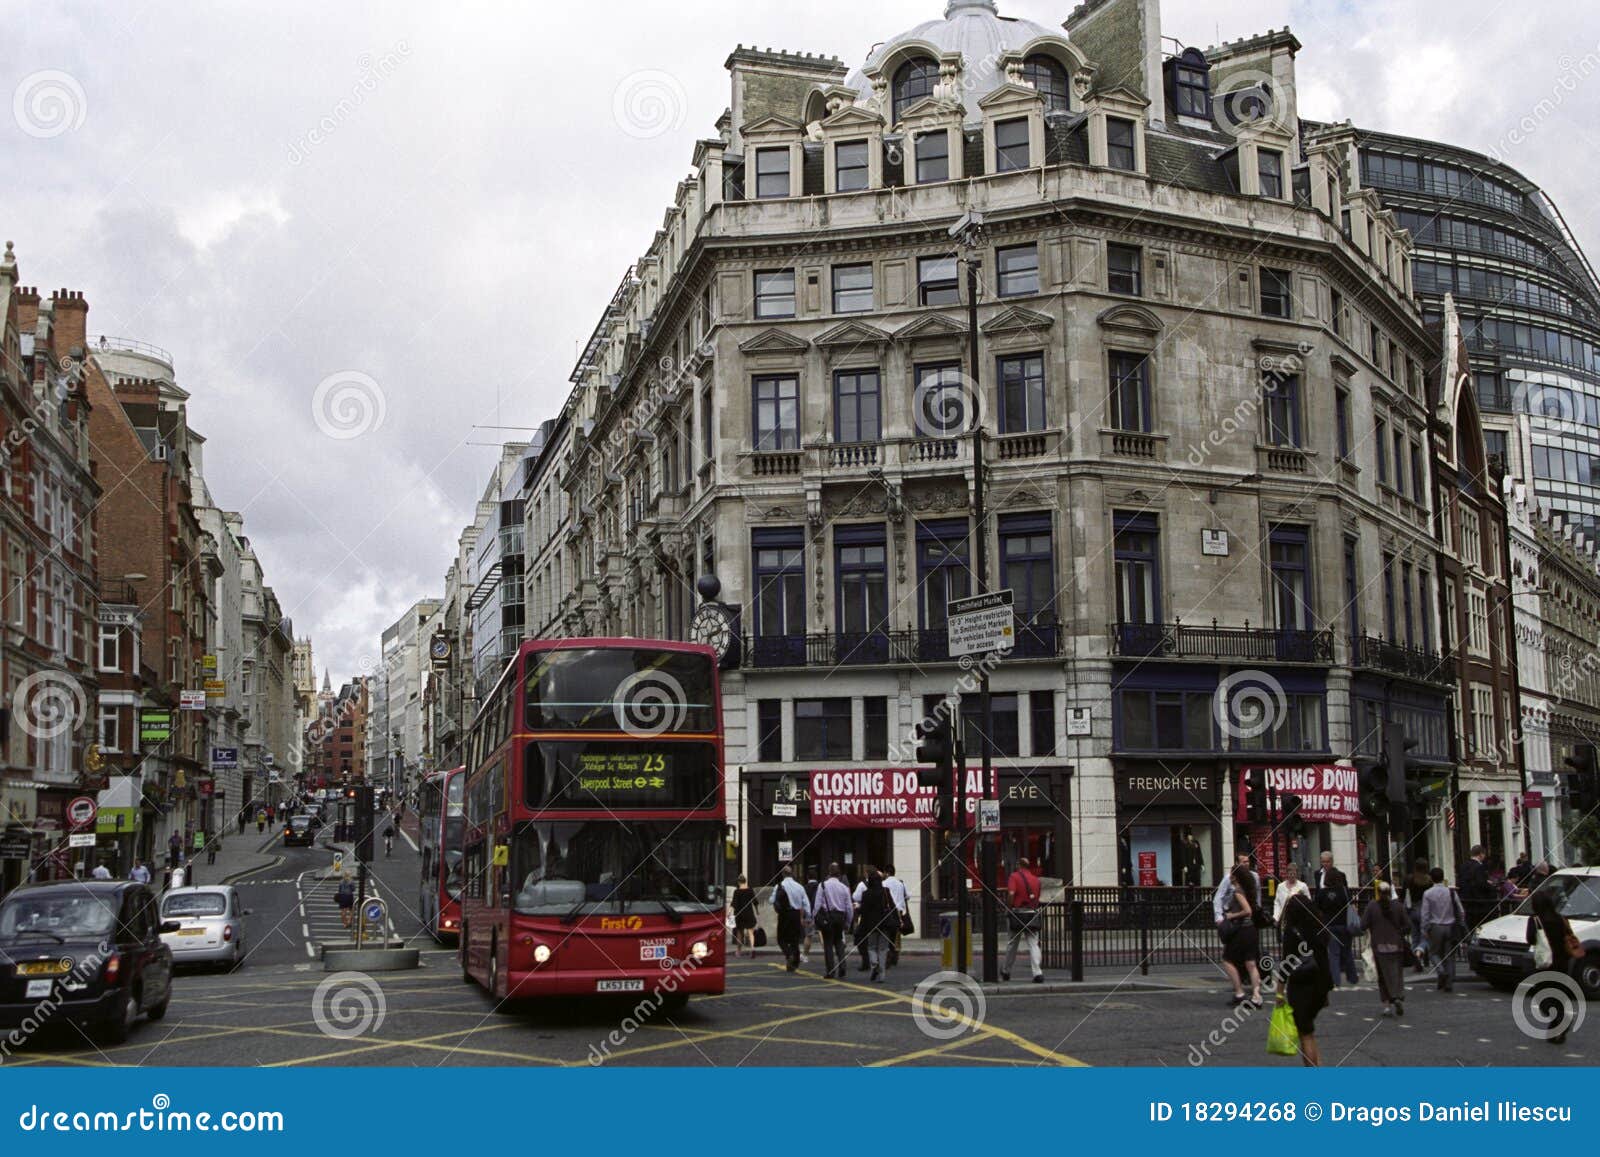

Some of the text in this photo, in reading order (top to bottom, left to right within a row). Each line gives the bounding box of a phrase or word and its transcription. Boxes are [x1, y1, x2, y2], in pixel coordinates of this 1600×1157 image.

[983, 595, 1003, 606] Market
[643, 754, 665, 772] 23
[580, 776, 633, 791] Liverpool Street
[813, 772, 884, 796] CLOSING
[1129, 777, 1208, 790] FRENCH EYE
[1009, 787, 1038, 798] EYE
[814, 798, 908, 815] EVERYTHING
[601, 917, 626, 929] First
